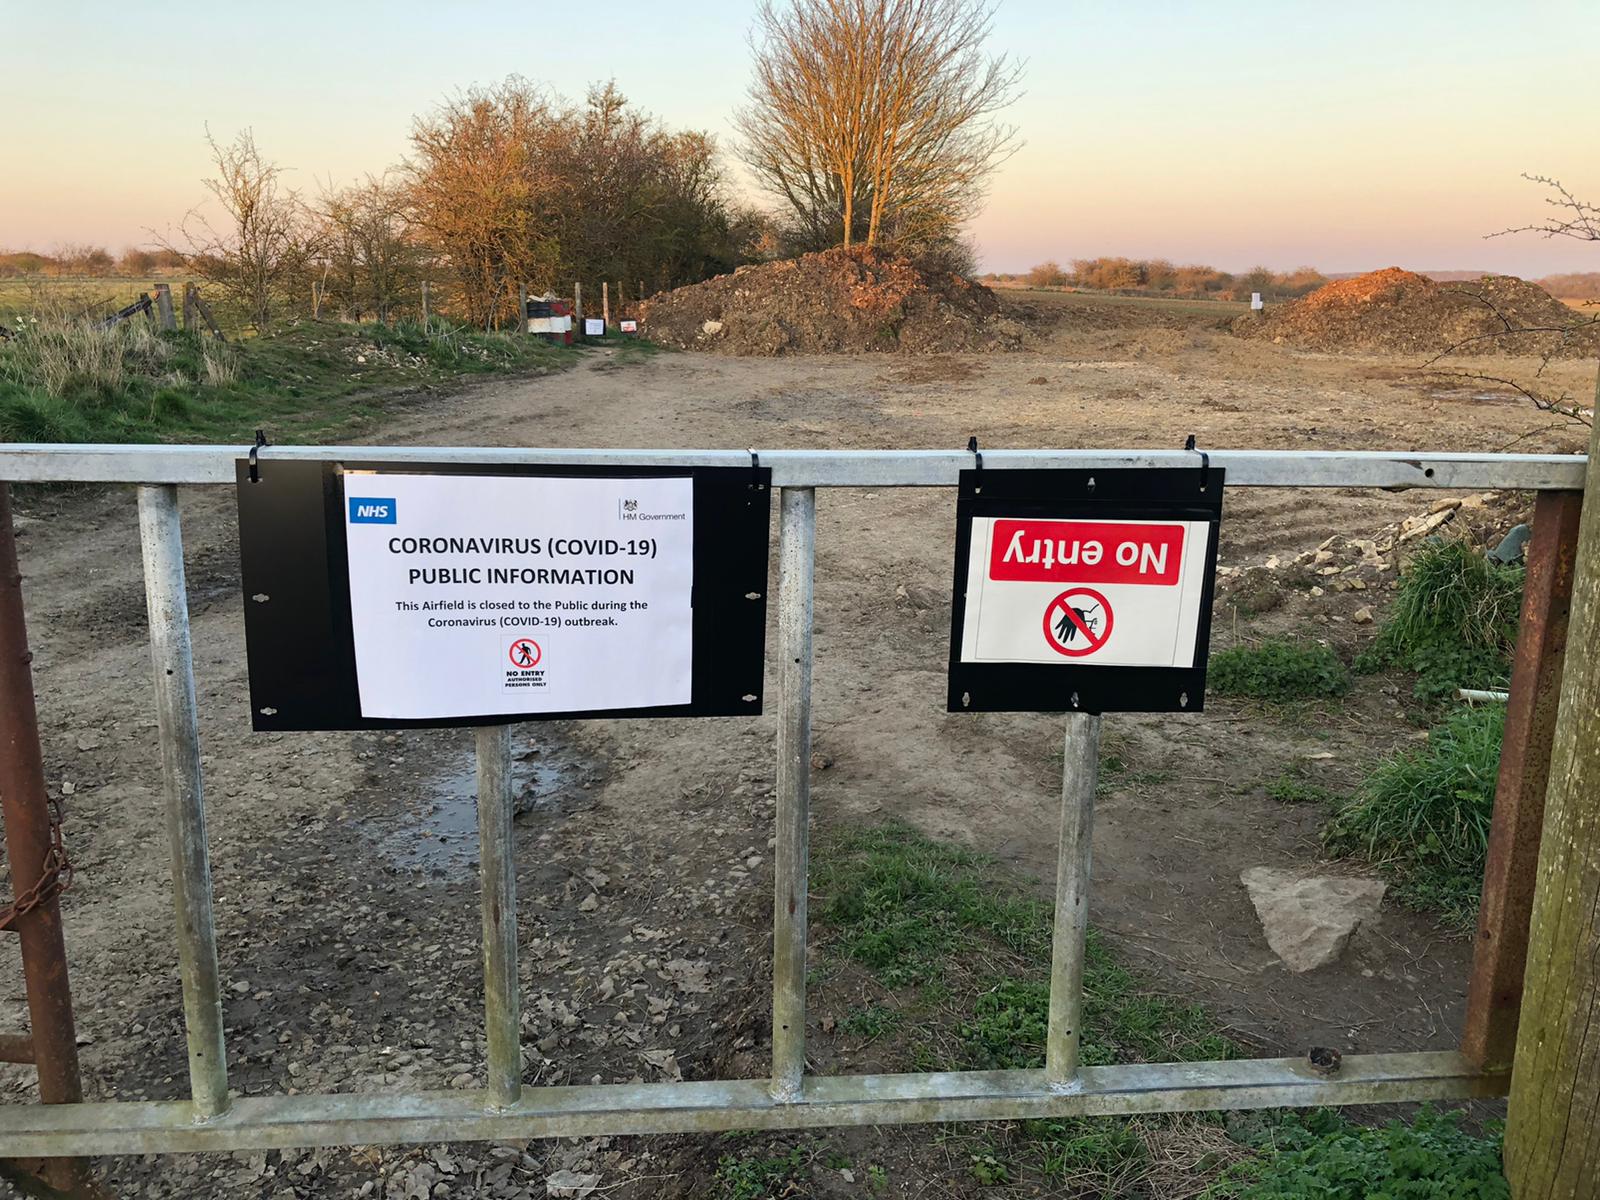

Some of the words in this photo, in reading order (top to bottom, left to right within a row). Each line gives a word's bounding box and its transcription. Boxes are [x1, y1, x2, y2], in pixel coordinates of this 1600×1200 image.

[357, 506, 388, 517] NHS
[623, 513, 637, 521] HM
[639, 513, 685, 521] Government
[389, 537, 541, 555] CORONAVIRUS
[548, 537, 657, 559] (COVID-19)
[1002, 530, 1103, 569] entry
[1116, 542, 1168, 574] No
[409, 568, 481, 584] PUBLIC
[488, 568, 634, 585] INFORMATION
[396, 601, 419, 611] This
[422, 600, 464, 611] Airfield
[468, 600, 476, 610] is
[479, 600, 515, 610] closed
[518, 601, 530, 610] to
[533, 600, 551, 610] the
[555, 600, 588, 610] Public
[591, 600, 627, 612] during
[629, 600, 648, 610] the
[428, 617, 496, 627] Coronavirus
[500, 616, 561, 628] (COVID-19)
[565, 616, 618, 627] outbreak.
